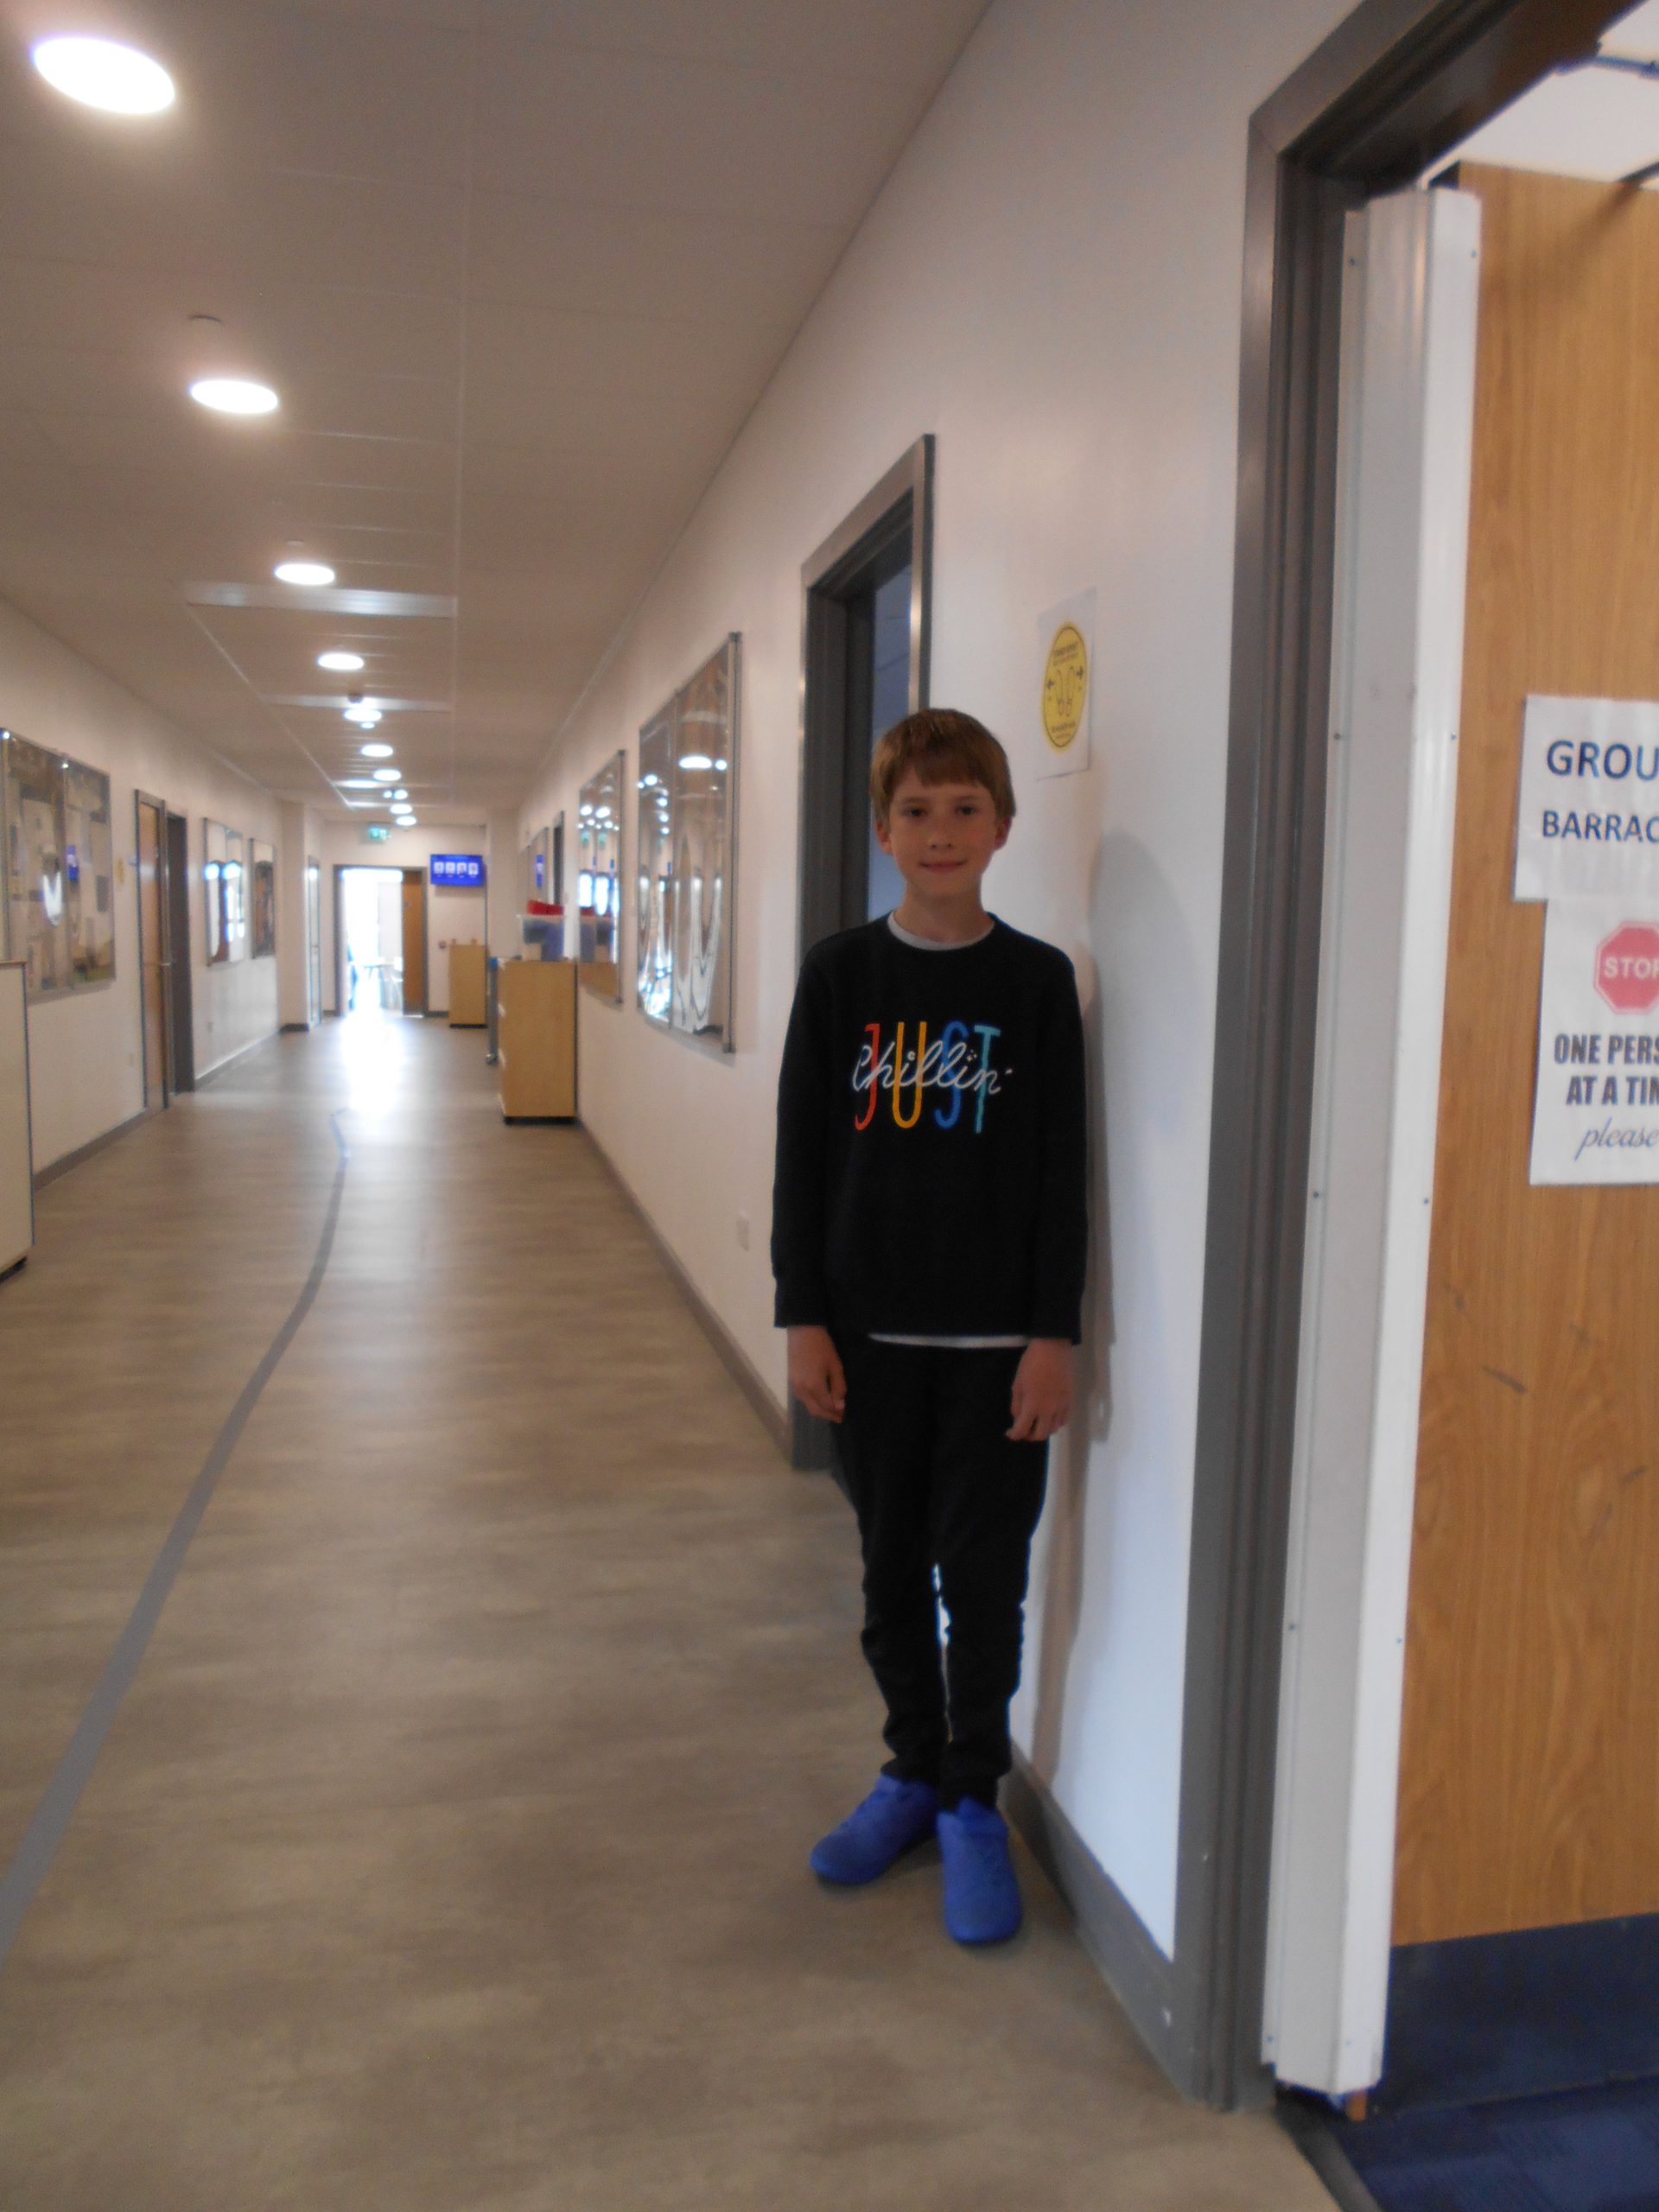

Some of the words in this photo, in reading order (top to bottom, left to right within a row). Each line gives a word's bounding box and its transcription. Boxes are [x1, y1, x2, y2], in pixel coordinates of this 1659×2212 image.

[1554, 1033, 1601, 1065] ONE
[855, 1020, 1001, 1134] JUST
[1566, 1076, 1598, 1106] AT
[1602, 1076, 1618, 1106] A
[1574, 1116, 1659, 1162] please
